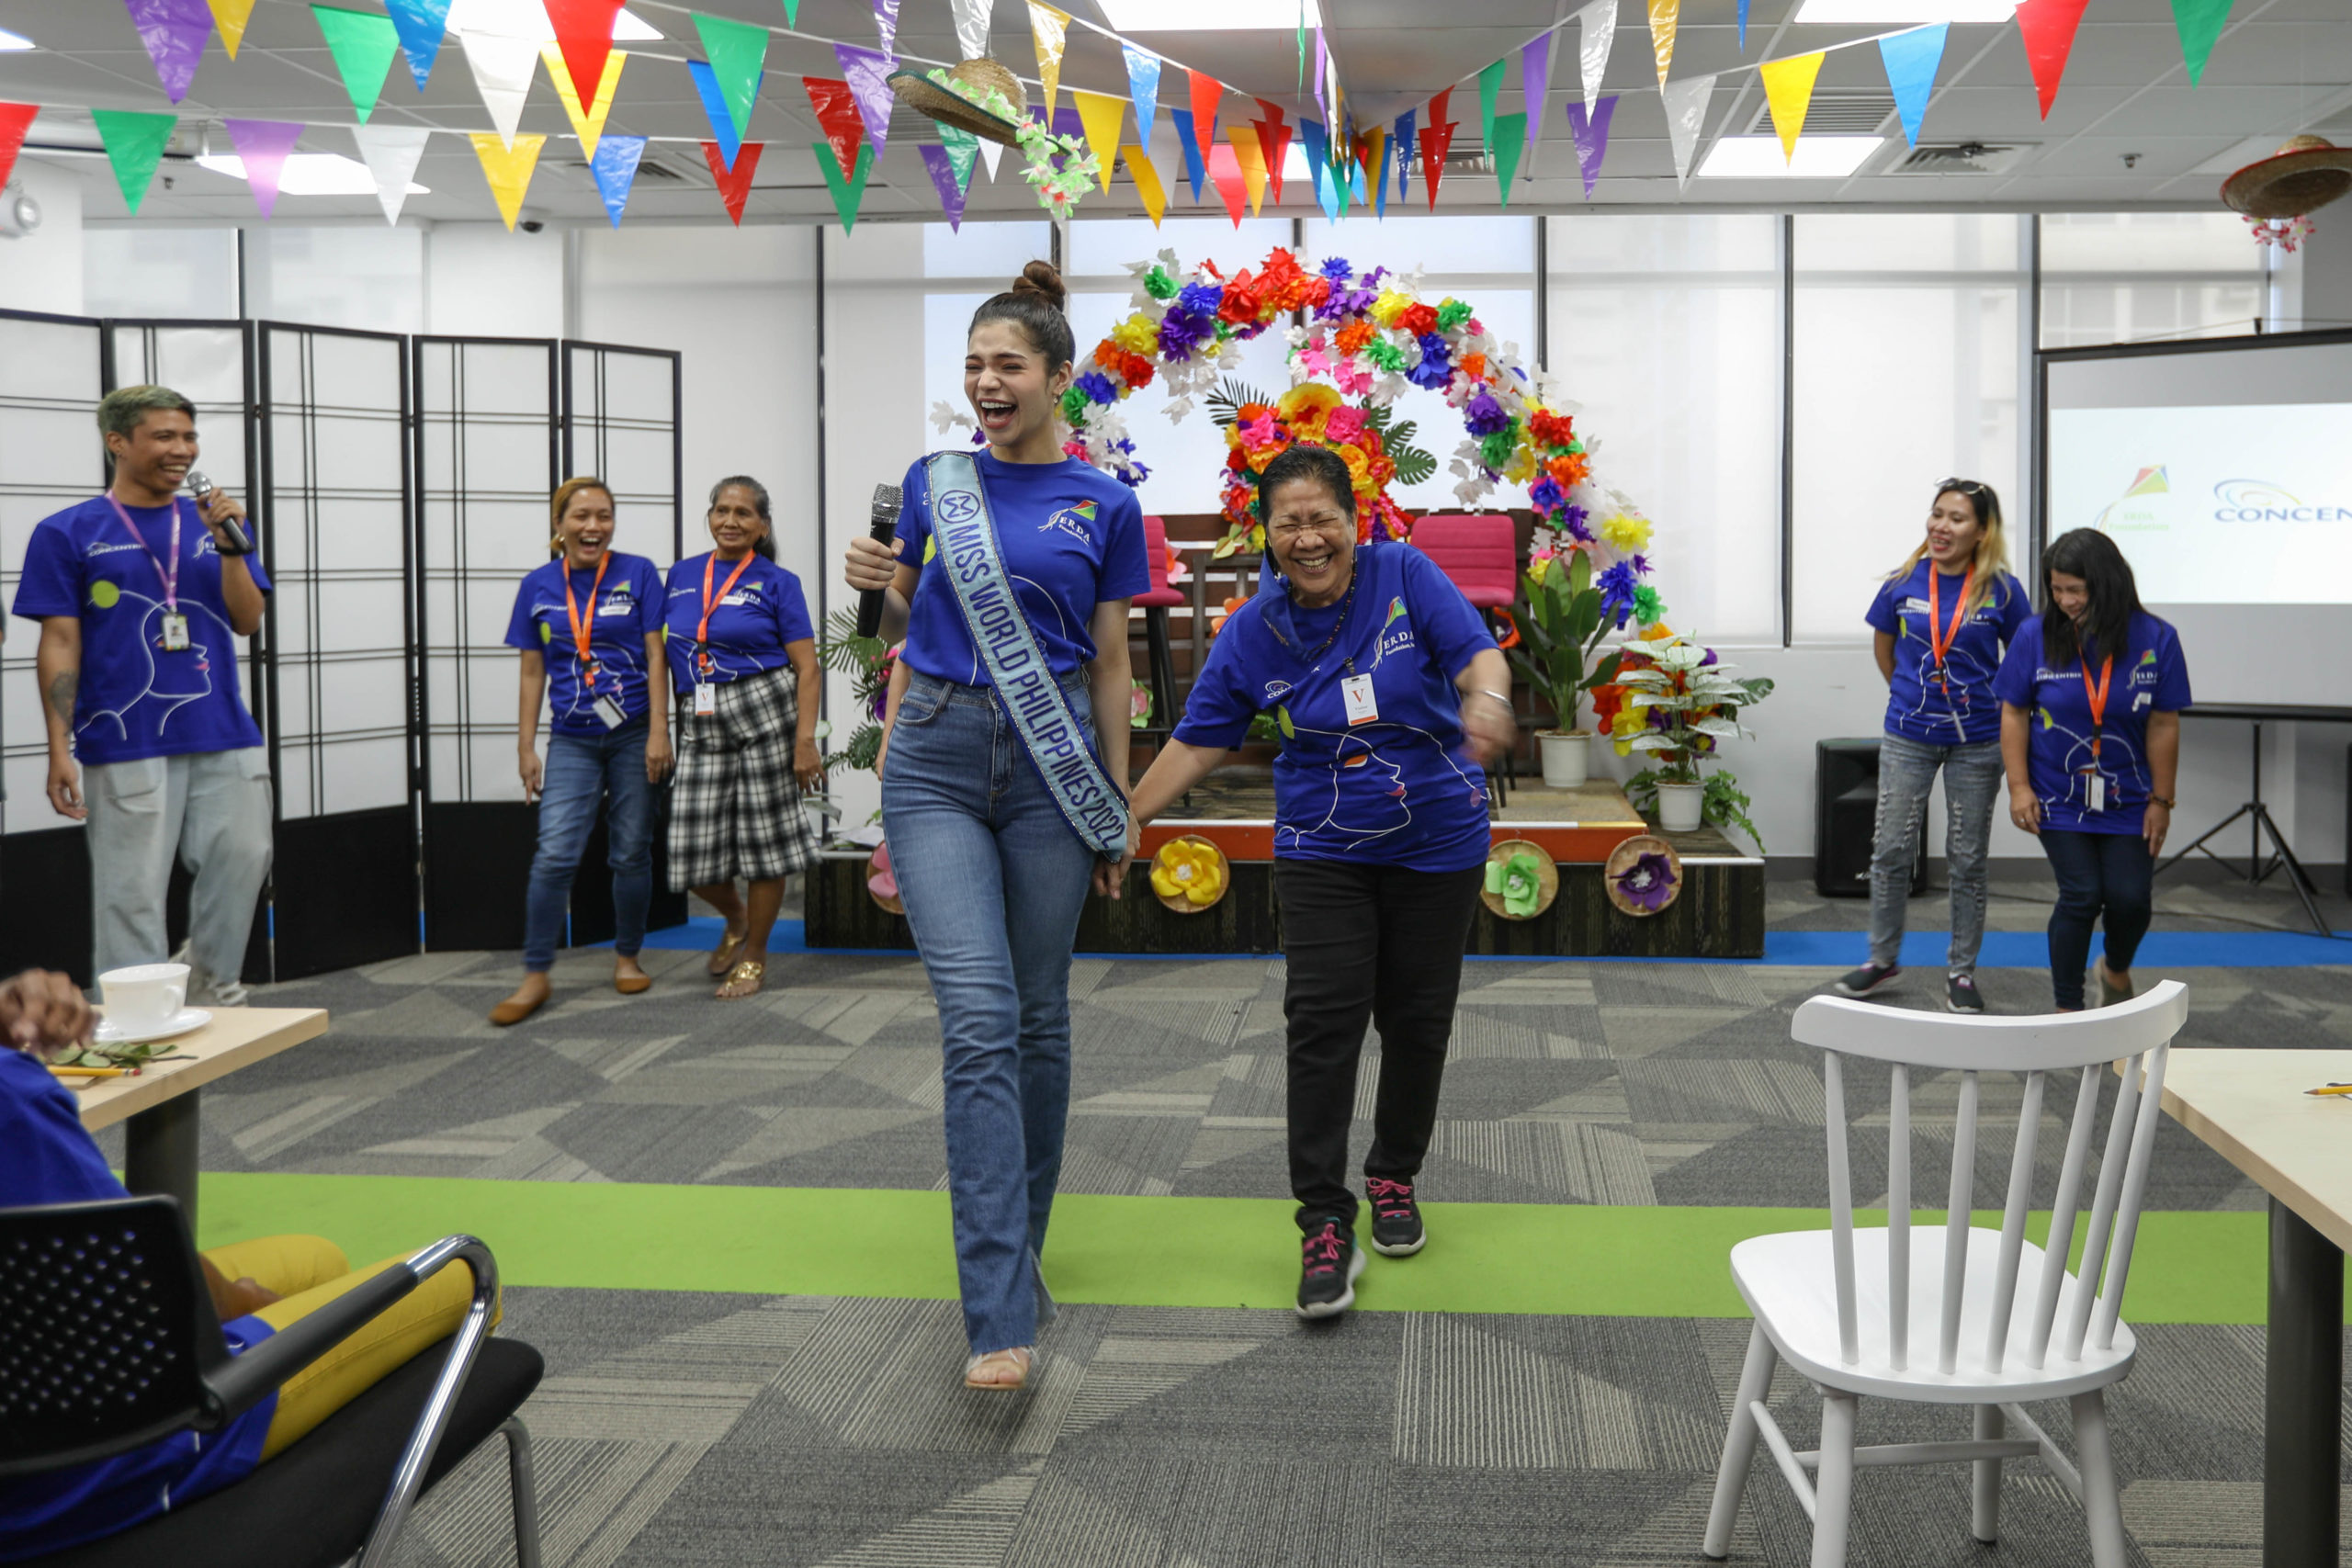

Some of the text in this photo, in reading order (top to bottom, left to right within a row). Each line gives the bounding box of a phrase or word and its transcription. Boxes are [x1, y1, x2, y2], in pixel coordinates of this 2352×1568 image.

[1058, 516, 1091, 543] ERDA
[946, 523, 1125, 849] MISS WORLD PHILIPPINES 2022
[1351, 688, 1365, 704] V
